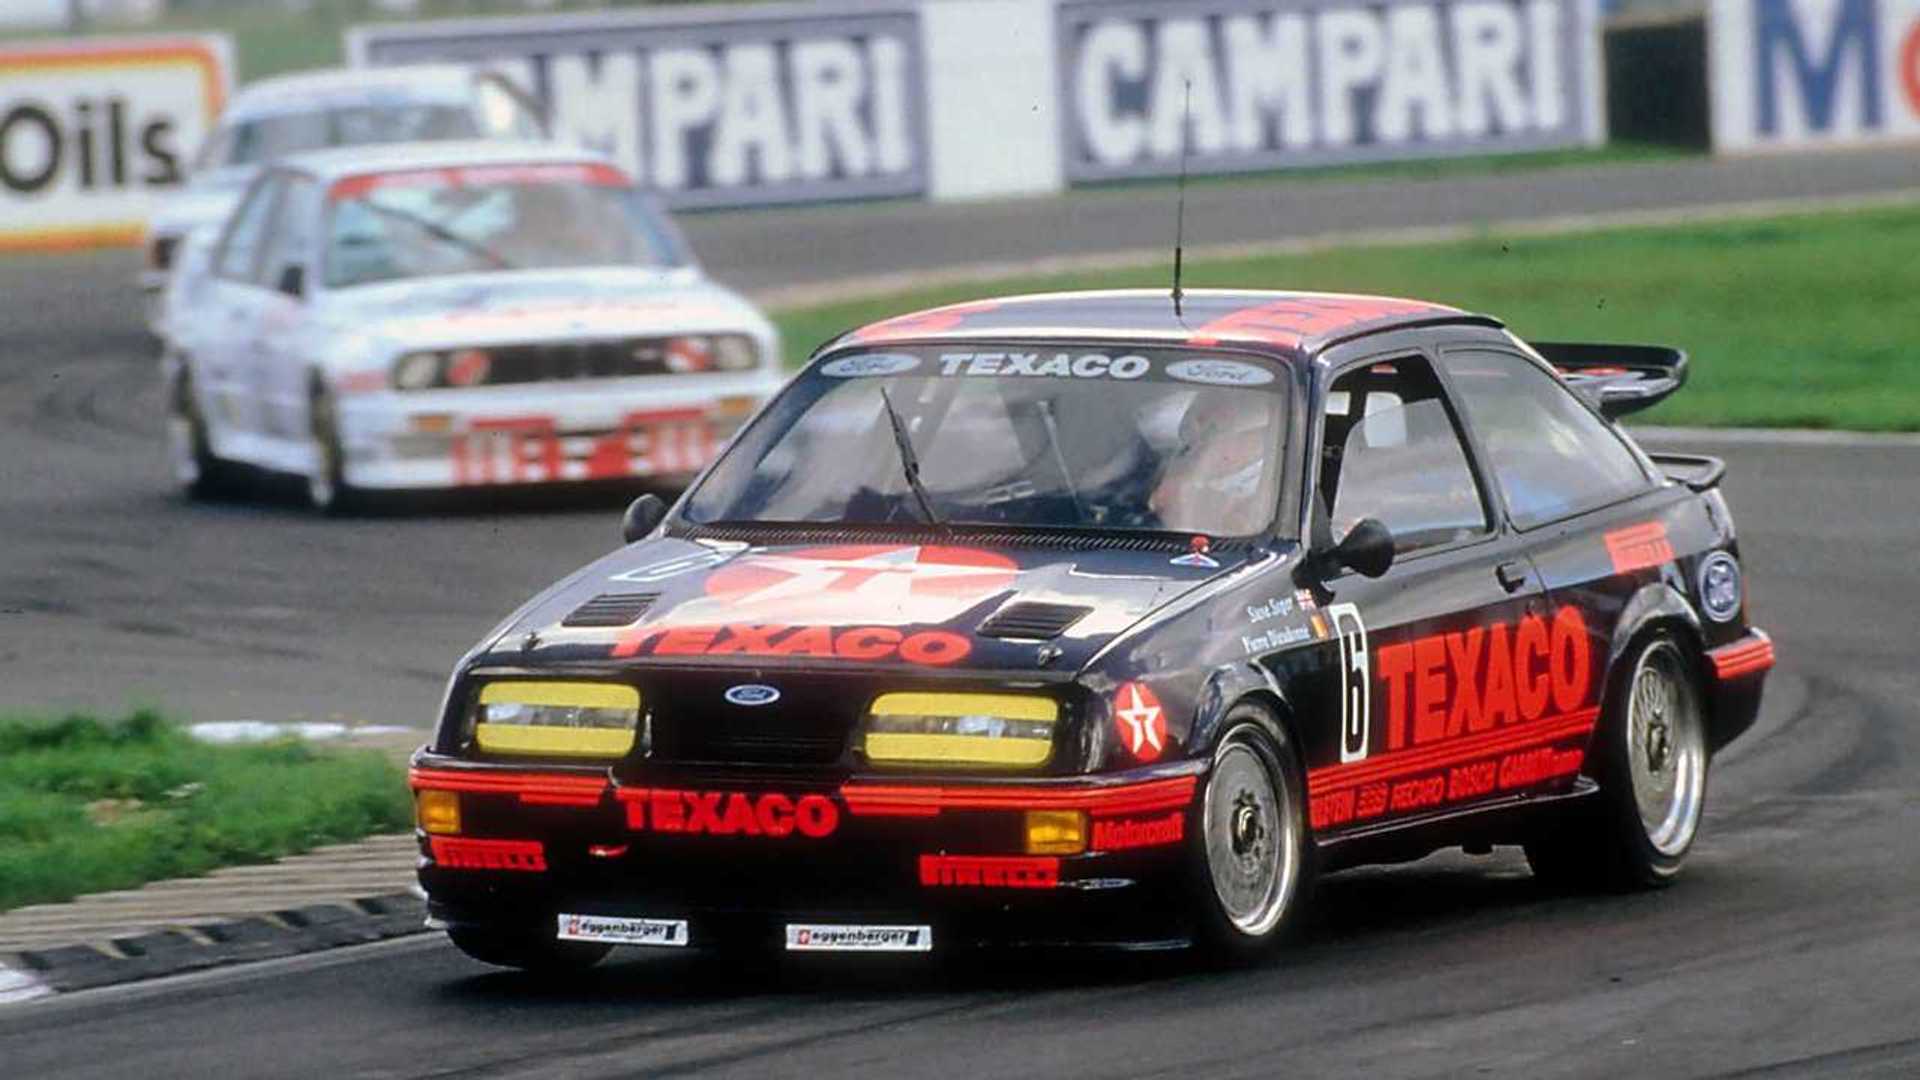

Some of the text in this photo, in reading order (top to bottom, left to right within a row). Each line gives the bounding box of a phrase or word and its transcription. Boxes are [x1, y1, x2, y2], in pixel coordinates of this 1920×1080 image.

[500, 36, 912, 190] MPARI
[1076, 1, 1562, 166] CAMPARI
[1752, 0, 1920, 133] M
[0, 97, 184, 192] Oils
[939, 353, 1150, 378] TEXACO
[609, 623, 973, 667] TEXACO
[1327, 601, 1370, 764] 6
[1376, 603, 1591, 751] TEXACO
[614, 786, 840, 838] TEXACO
[811, 929, 906, 943] eggenberger
